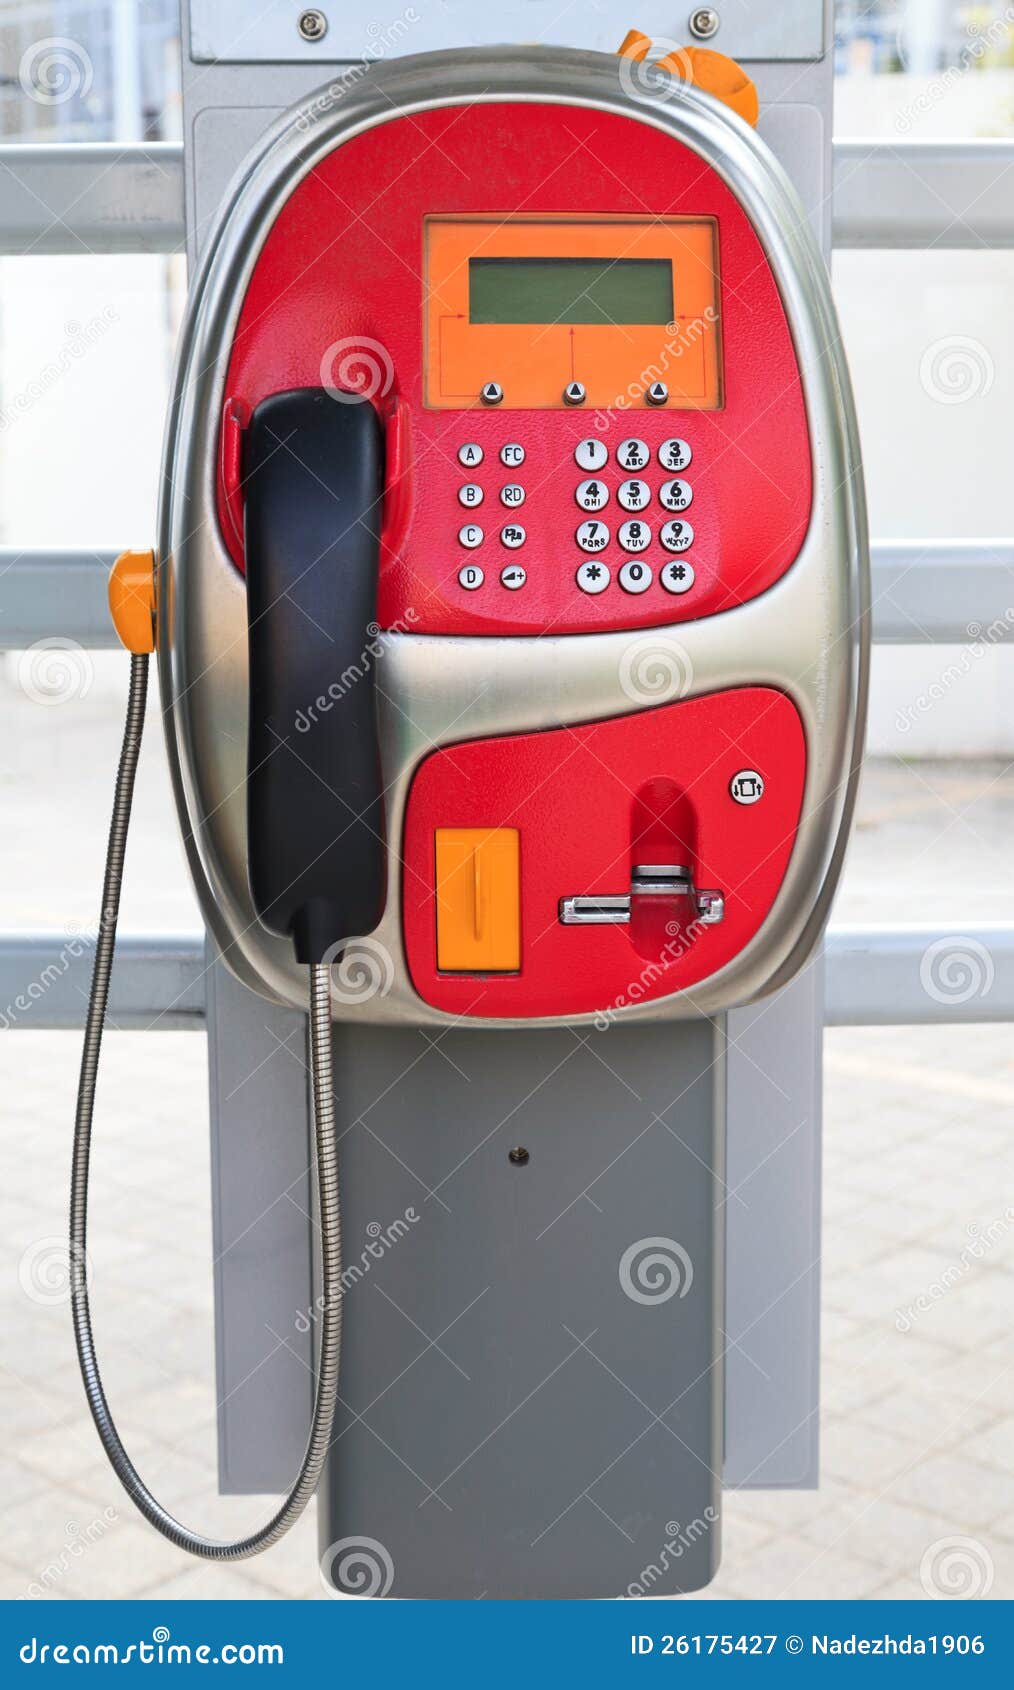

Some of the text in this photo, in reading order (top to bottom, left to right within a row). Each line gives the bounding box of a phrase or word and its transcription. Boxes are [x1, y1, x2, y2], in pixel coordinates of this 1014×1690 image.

[466, 447, 475, 461] A
[504, 447, 522, 461] FC
[587, 441, 595, 457] 1
[628, 441, 639, 457] 2
[669, 441, 681, 458] 3
[625, 458, 644, 466] ABC
[466, 487, 476, 502] B
[504, 488, 522, 502] RD
[586, 482, 600, 497] 4
[627, 482, 641, 497] 5
[670, 482, 682, 497] 6
[584, 498, 601, 507] GHI
[467, 528, 476, 542] C
[587, 523, 599, 539] 7
[629, 522, 641, 538] 8
[671, 522, 683, 538] 9
[582, 537, 605, 547] PQRS
[626, 539, 644, 547] TUV
[466, 569, 476, 584] D
[629, 564, 643, 580] 0
[670, 565, 686, 580] #
